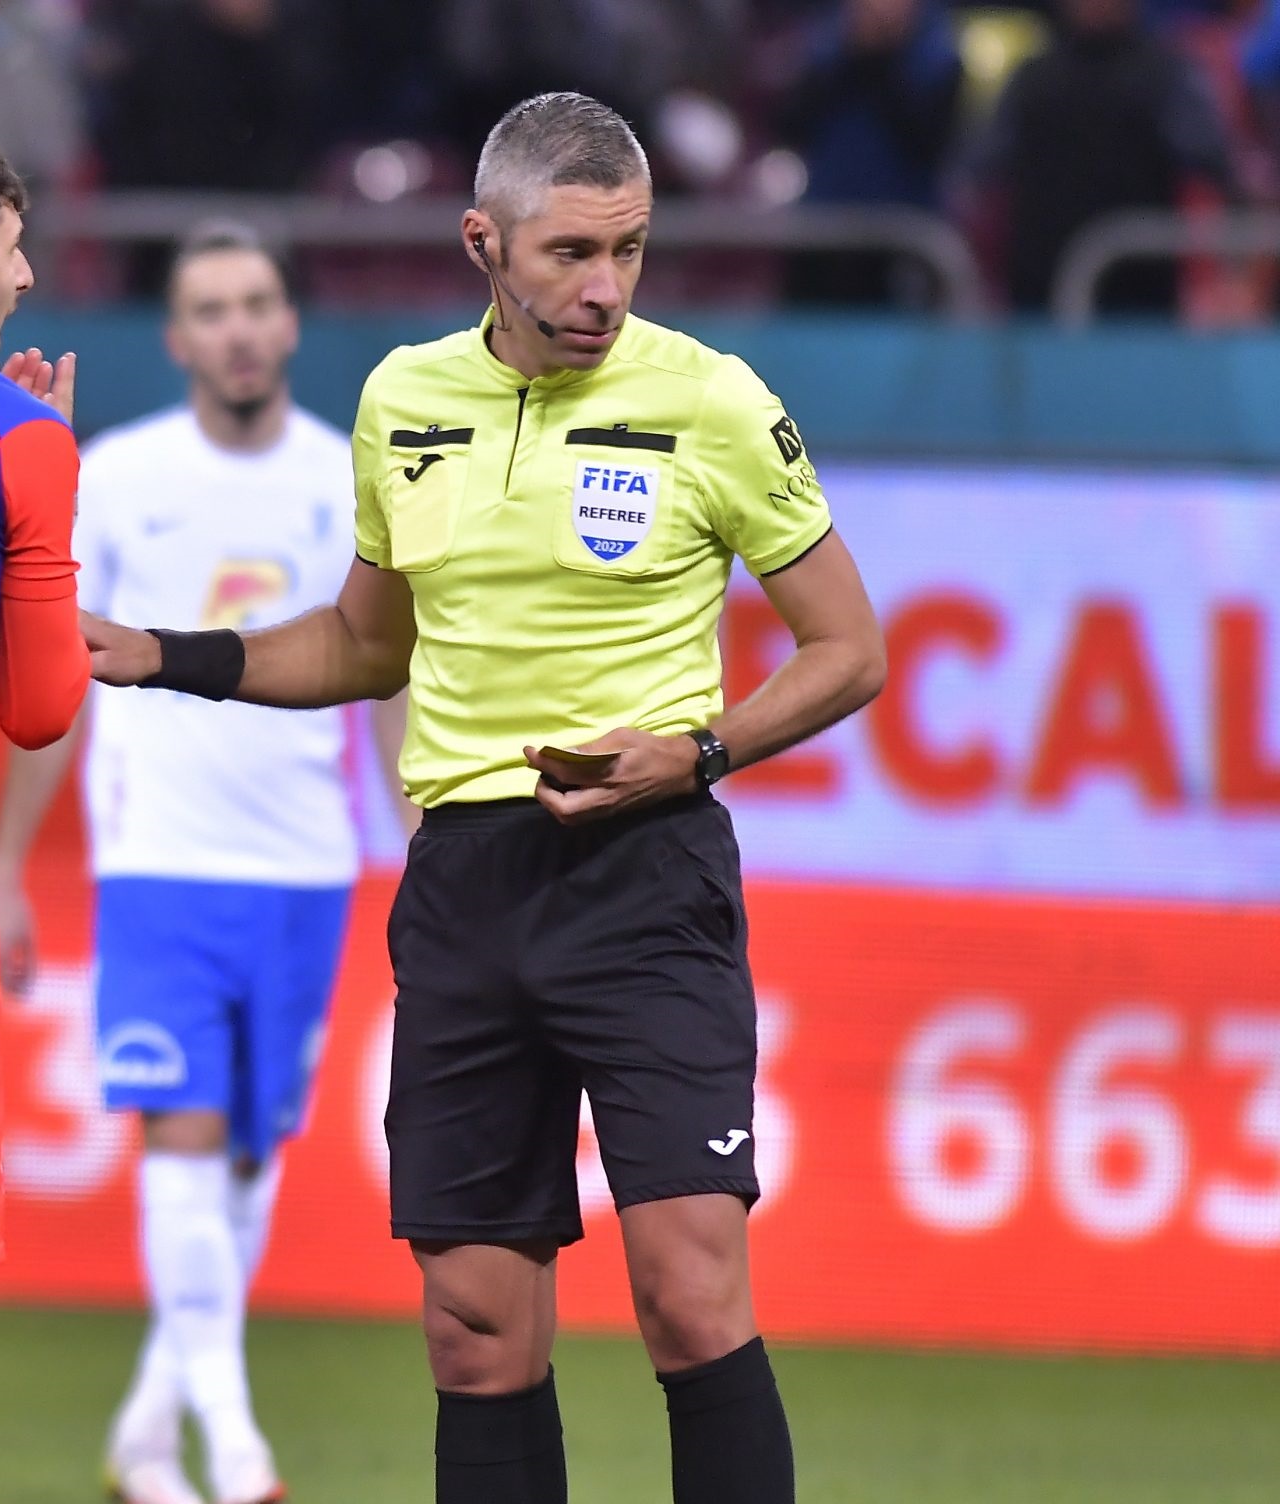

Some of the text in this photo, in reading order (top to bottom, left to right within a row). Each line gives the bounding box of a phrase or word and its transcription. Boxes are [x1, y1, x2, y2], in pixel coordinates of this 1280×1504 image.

[583, 467, 648, 495] FIFA
[579, 506, 646, 524] REFEREE
[593, 540, 625, 554] 2022
